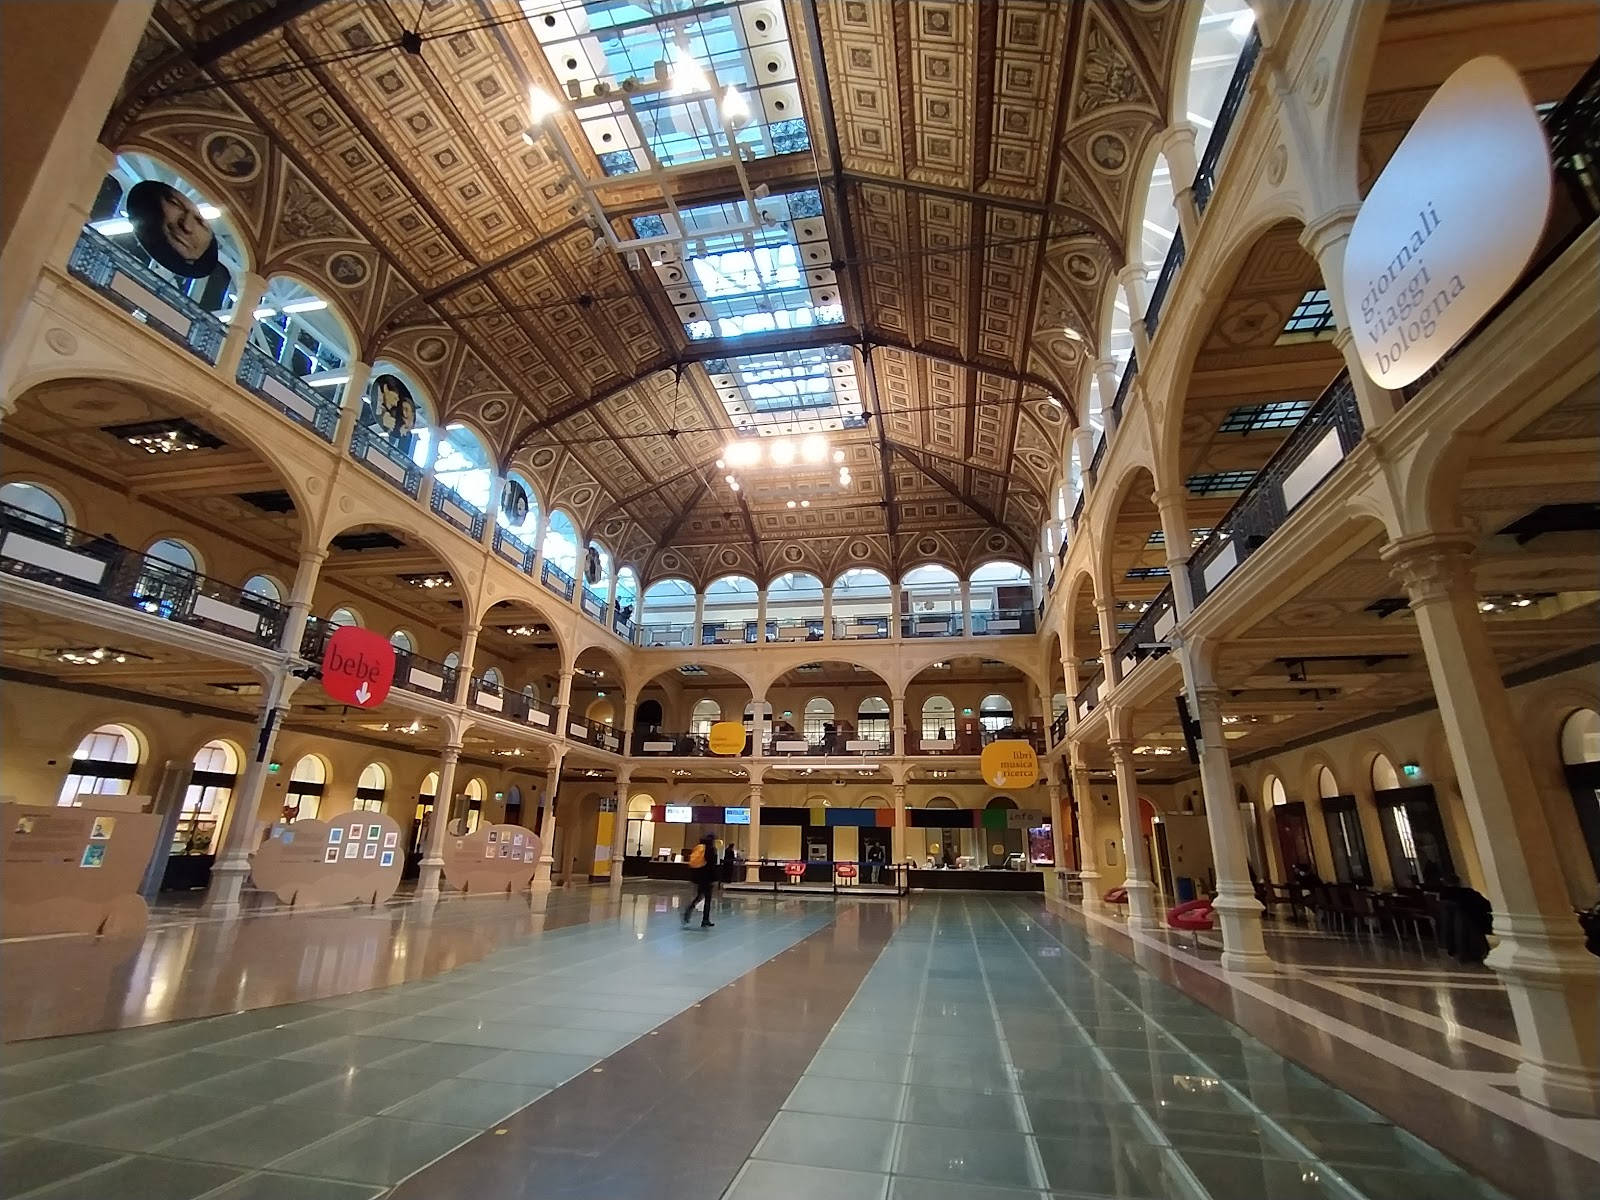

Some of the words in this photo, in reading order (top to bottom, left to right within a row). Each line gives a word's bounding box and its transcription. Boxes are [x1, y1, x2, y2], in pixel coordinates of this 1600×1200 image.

[1361, 202, 1442, 324] giornali
[1368, 259, 1432, 345] viaggi
[1374, 274, 1466, 375] bologna
[329, 643, 380, 683] bebè
[1000, 759, 1033, 768] musica
[1013, 751, 1032, 759] libri
[1003, 768, 1034, 777] ricerca
[1009, 812, 1034, 821] info
